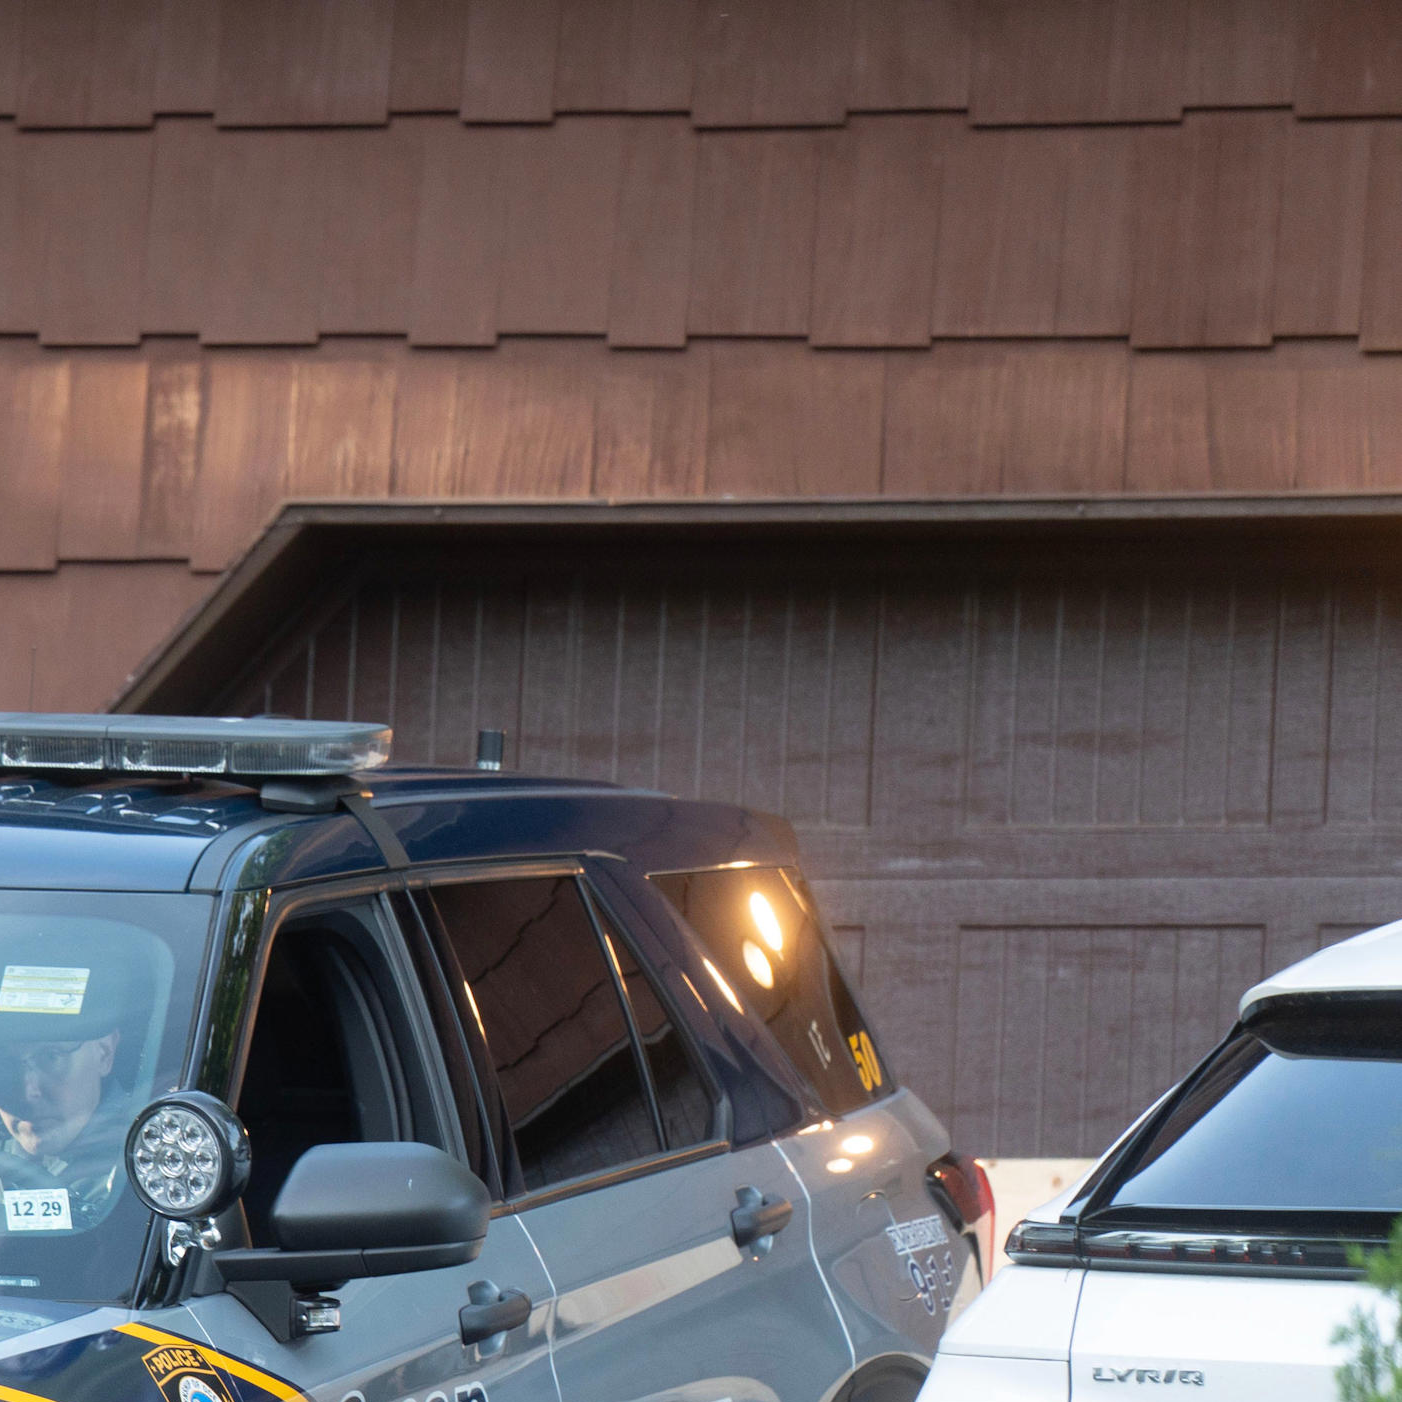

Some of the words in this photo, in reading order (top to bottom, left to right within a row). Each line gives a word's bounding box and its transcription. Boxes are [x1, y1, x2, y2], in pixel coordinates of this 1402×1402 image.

[848, 1030, 882, 1092] 50
[12, 1201, 35, 1217] 12
[41, 1201, 63, 1217] 29
[151, 1349, 200, 1375] POLICE
[1092, 1367, 1205, 1386] LYRIQ
